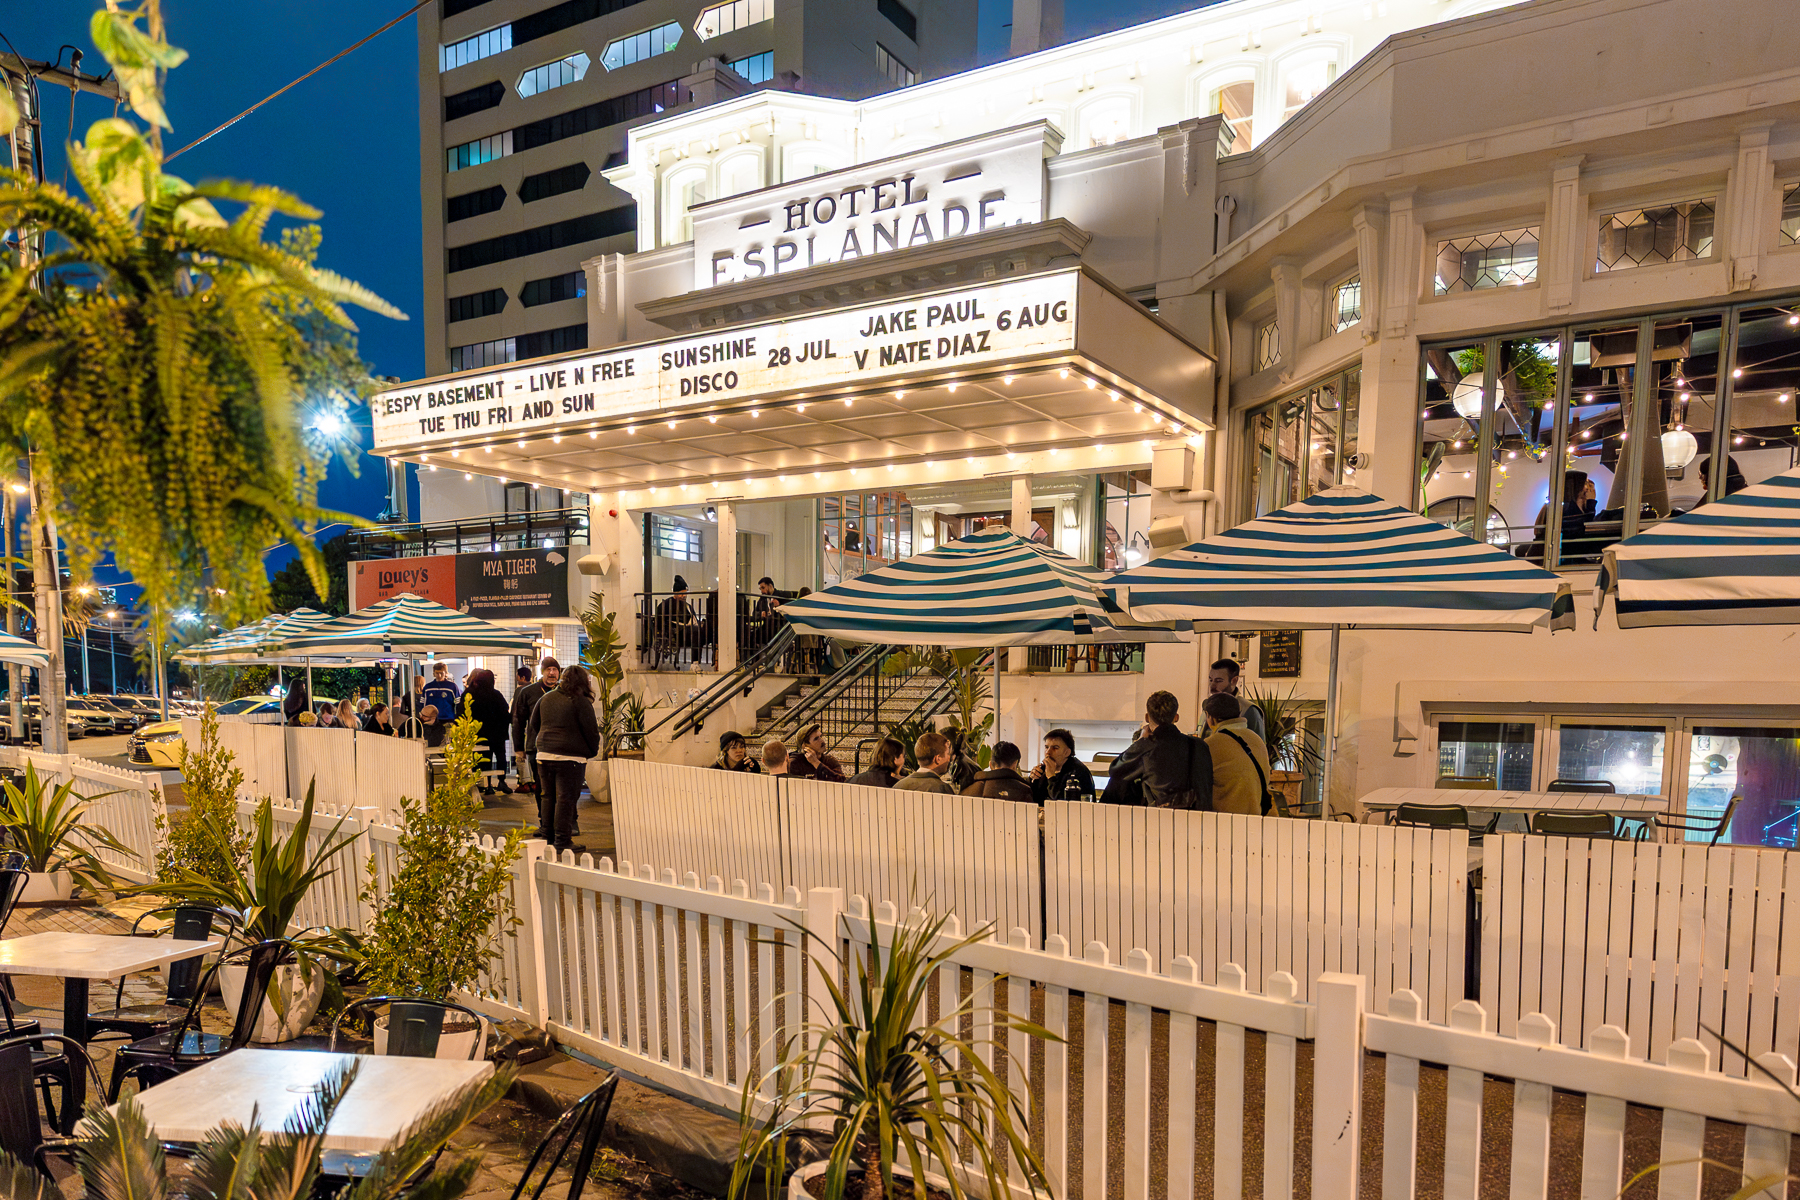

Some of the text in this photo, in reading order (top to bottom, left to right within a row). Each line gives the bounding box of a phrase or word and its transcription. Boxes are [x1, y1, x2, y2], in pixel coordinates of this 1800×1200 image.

[783, 176, 928, 233] HOTEL
[711, 191, 1007, 286] ESPLANADE
[860, 298, 985, 338] JAKE PAUL
[996, 300, 1068, 331] 6 AUG
[661, 337, 757, 372] SUNSHINE
[767, 338, 837, 369] 28 JUL
[854, 329, 991, 370] V NATE DIAZ
[386, 394, 422, 415] ESPY
[427, 380, 504, 409] BASEMENT
[529, 369, 566, 393] LIVE
[574, 366, 585, 385] N
[592, 358, 635, 383] FREE
[680, 370, 739, 397] DISCO
[419, 392, 595, 435] TUE THU FRI AND SUN
[379, 567, 429, 589] Louey's
[483, 558, 537, 577] MYA TIGER
